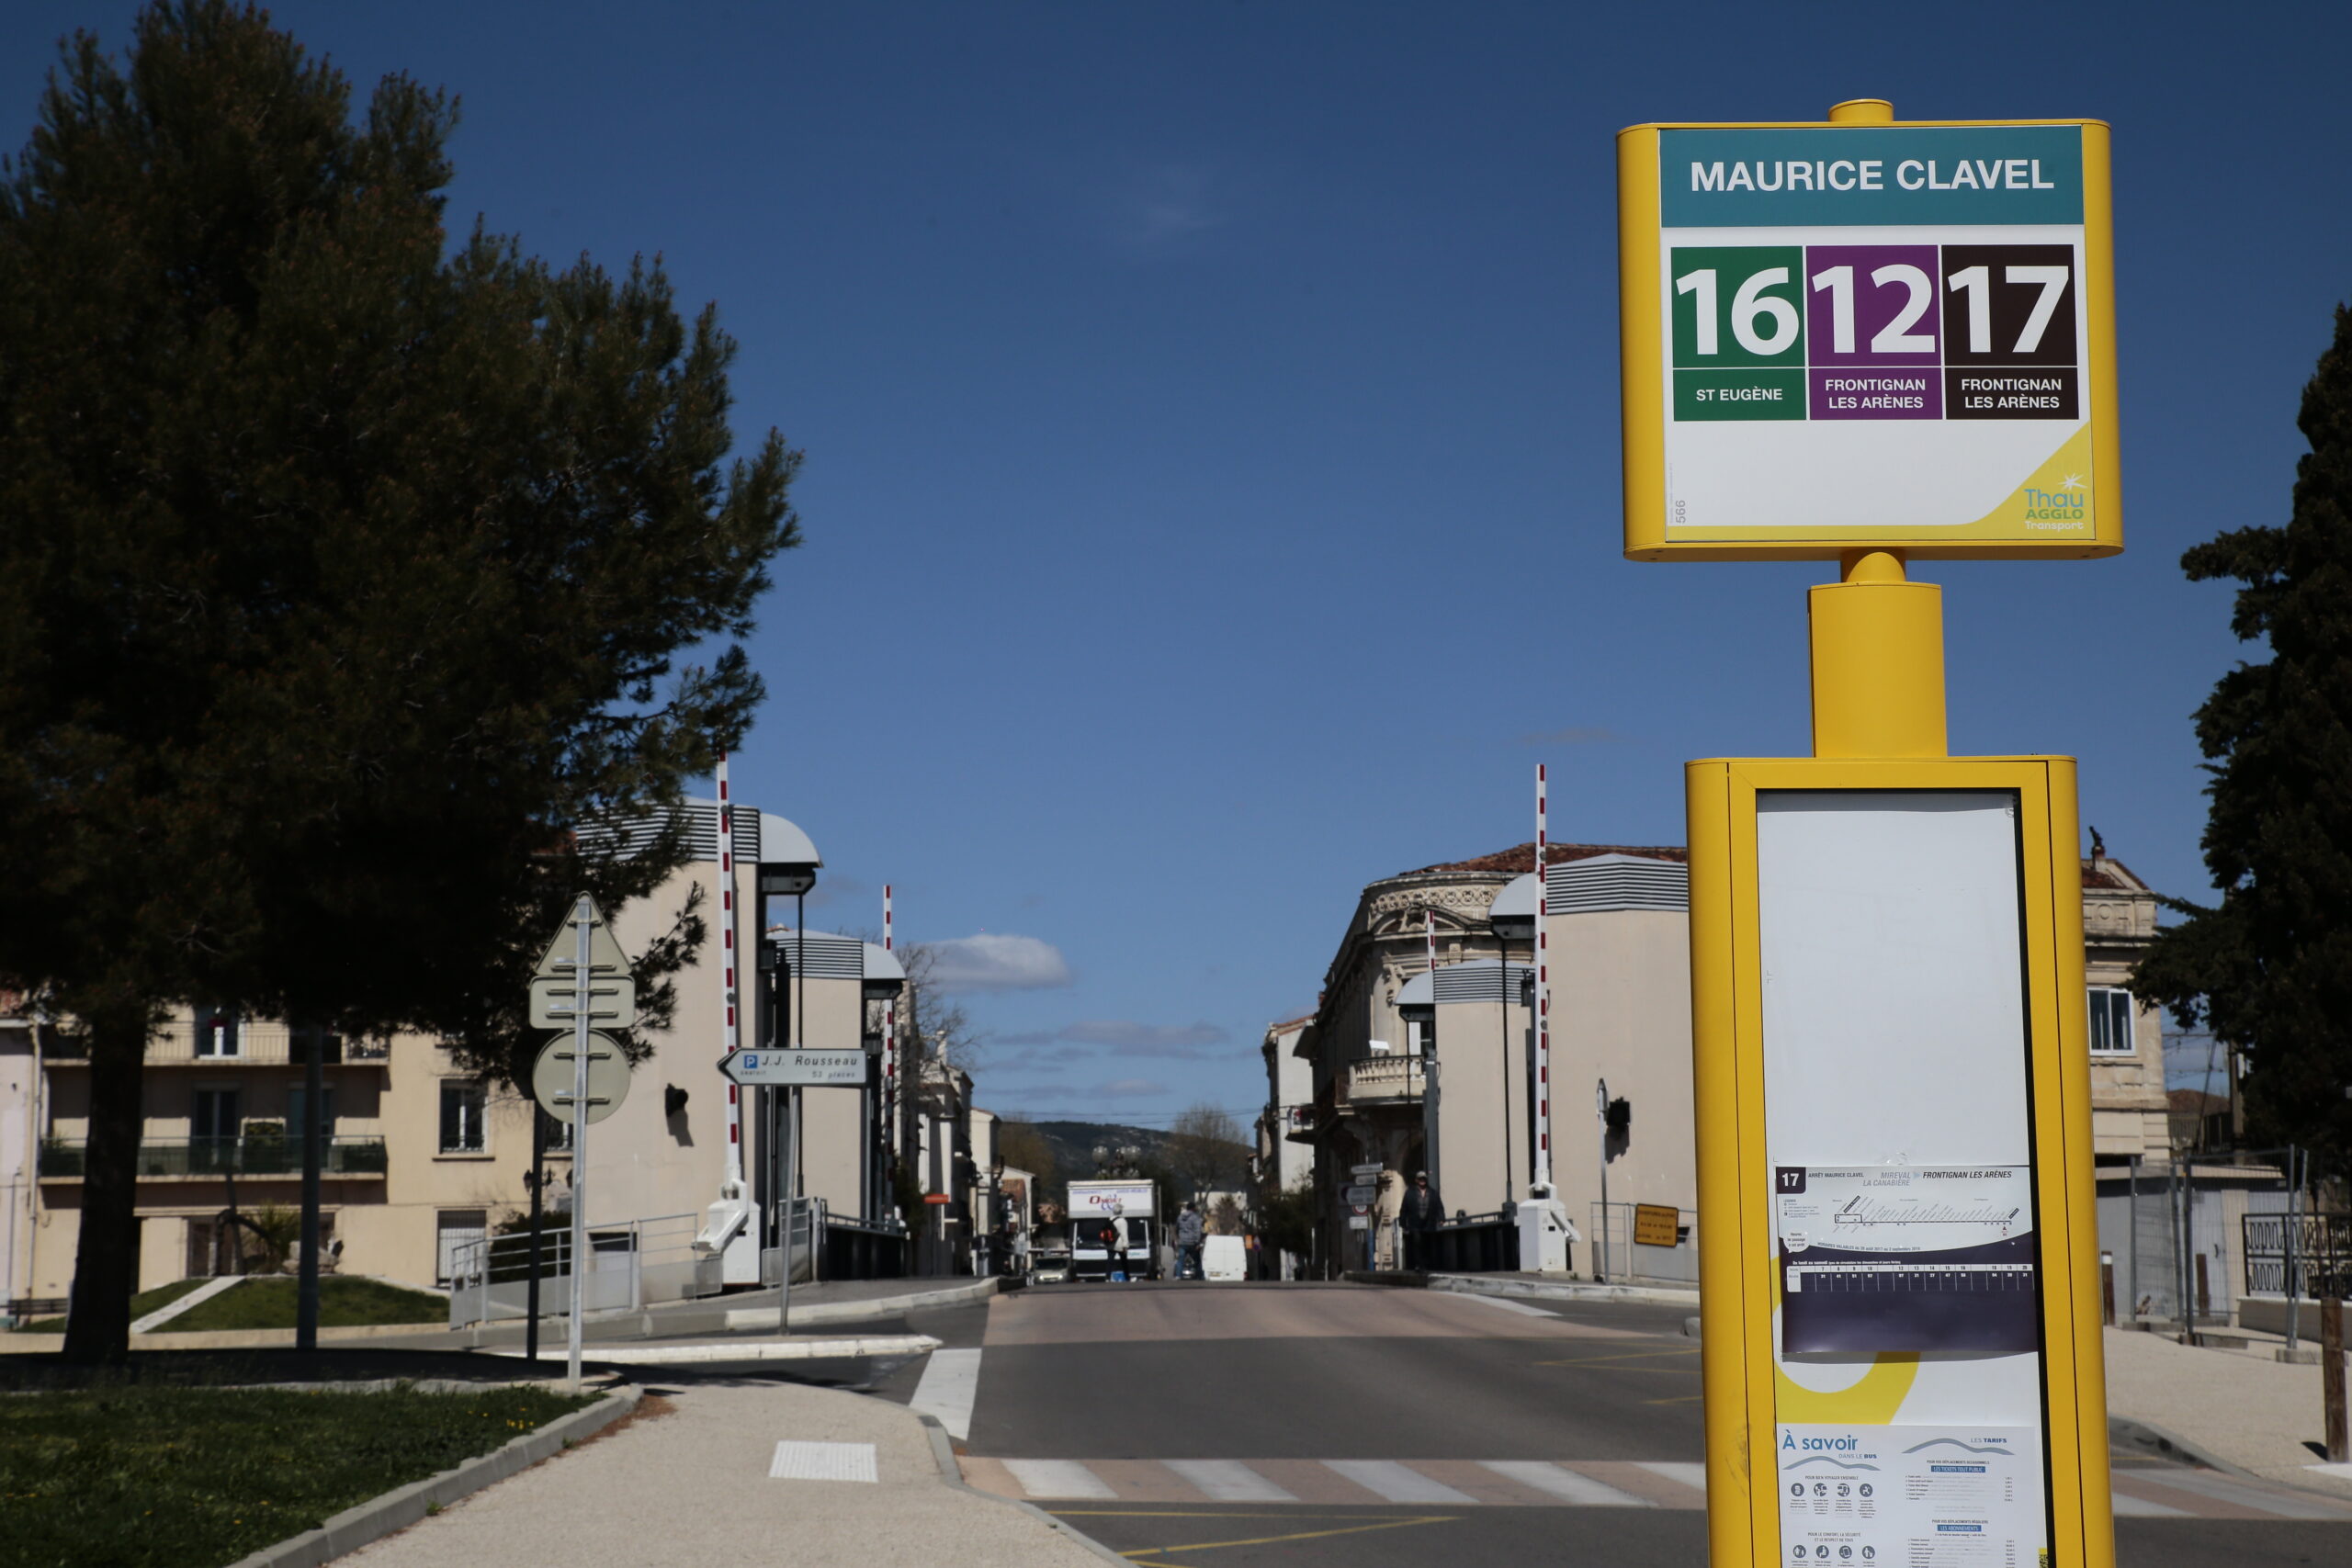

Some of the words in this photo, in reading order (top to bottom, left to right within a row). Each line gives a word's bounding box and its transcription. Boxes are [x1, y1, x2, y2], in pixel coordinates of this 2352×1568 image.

[1690, 161, 1883, 191] MAURICE
[1896, 159, 2054, 189] CLAVEL
[1675, 266, 1800, 356] 16
[1812, 264, 1936, 355] 12
[1947, 265, 2069, 354] 17
[1825, 378, 1927, 392] FRONTIGNAN
[1961, 378, 2063, 391] FRONTIGNAN
[1695, 389, 1715, 401] ST
[1719, 385, 1783, 402] EUGÈNE
[1827, 396, 1858, 410] LES
[1860, 393, 1924, 410] ARÈNES
[1964, 396, 1994, 410] LES
[1996, 392, 2060, 410] ARÈNES
[2024, 489, 2084, 508] Thau
[1675, 500, 1687, 524] 566
[2025, 509, 2085, 520] AGGLO
[2024, 521, 2085, 532] Transport
[795, 1055, 858, 1066] Rousseau
[1781, 1172, 1800, 1187] 17
[1880, 1171, 1911, 1179] MIREVAL
[1984, 1169, 2012, 1179] ARÈNES
[1873, 1179, 1910, 1187] CANABIÈRE
[1782, 1428, 1796, 1450] À
[1802, 1434, 1858, 1450] savoir
